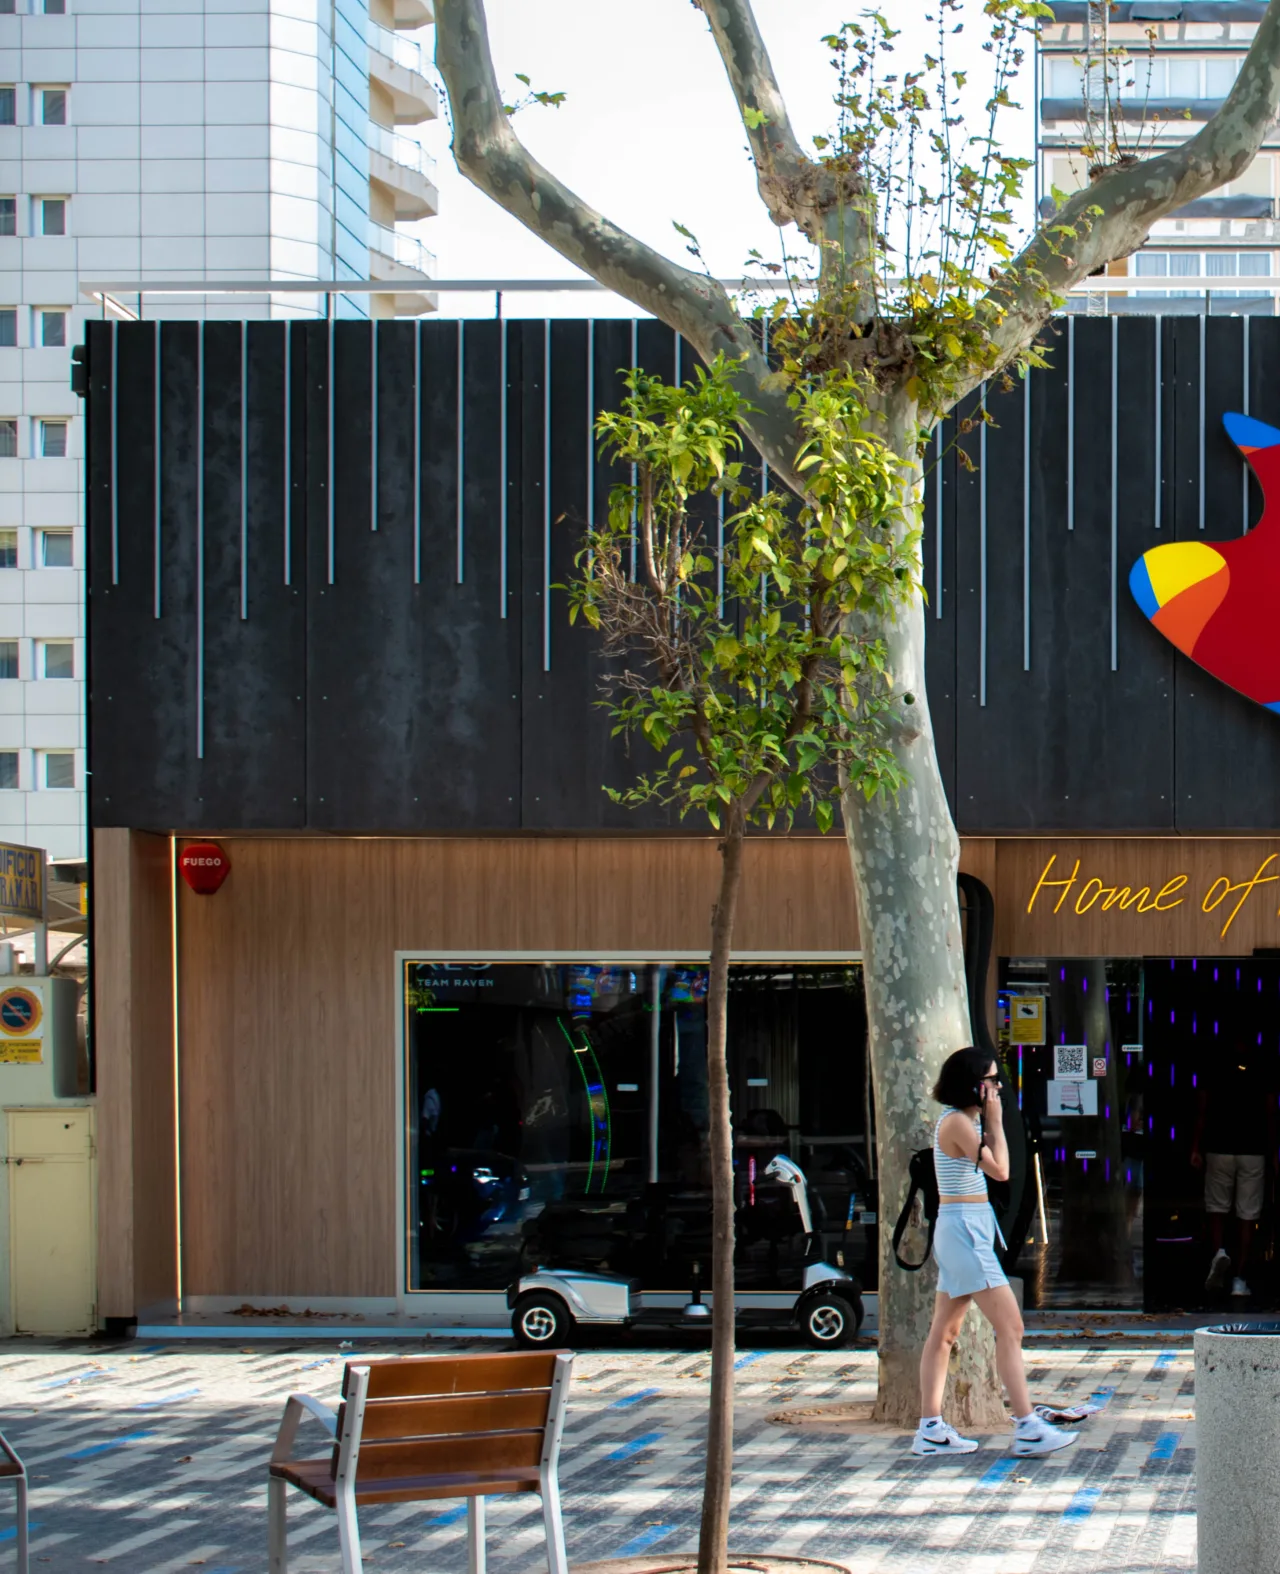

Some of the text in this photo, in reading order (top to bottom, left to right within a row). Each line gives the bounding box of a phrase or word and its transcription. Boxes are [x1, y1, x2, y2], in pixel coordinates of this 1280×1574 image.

[183, 857, 222, 867] FUEGO
[1027, 854, 1188, 915] Home
[1201, 853, 1280, 942] of
[417, 979, 494, 987] TEAM RAVEN
